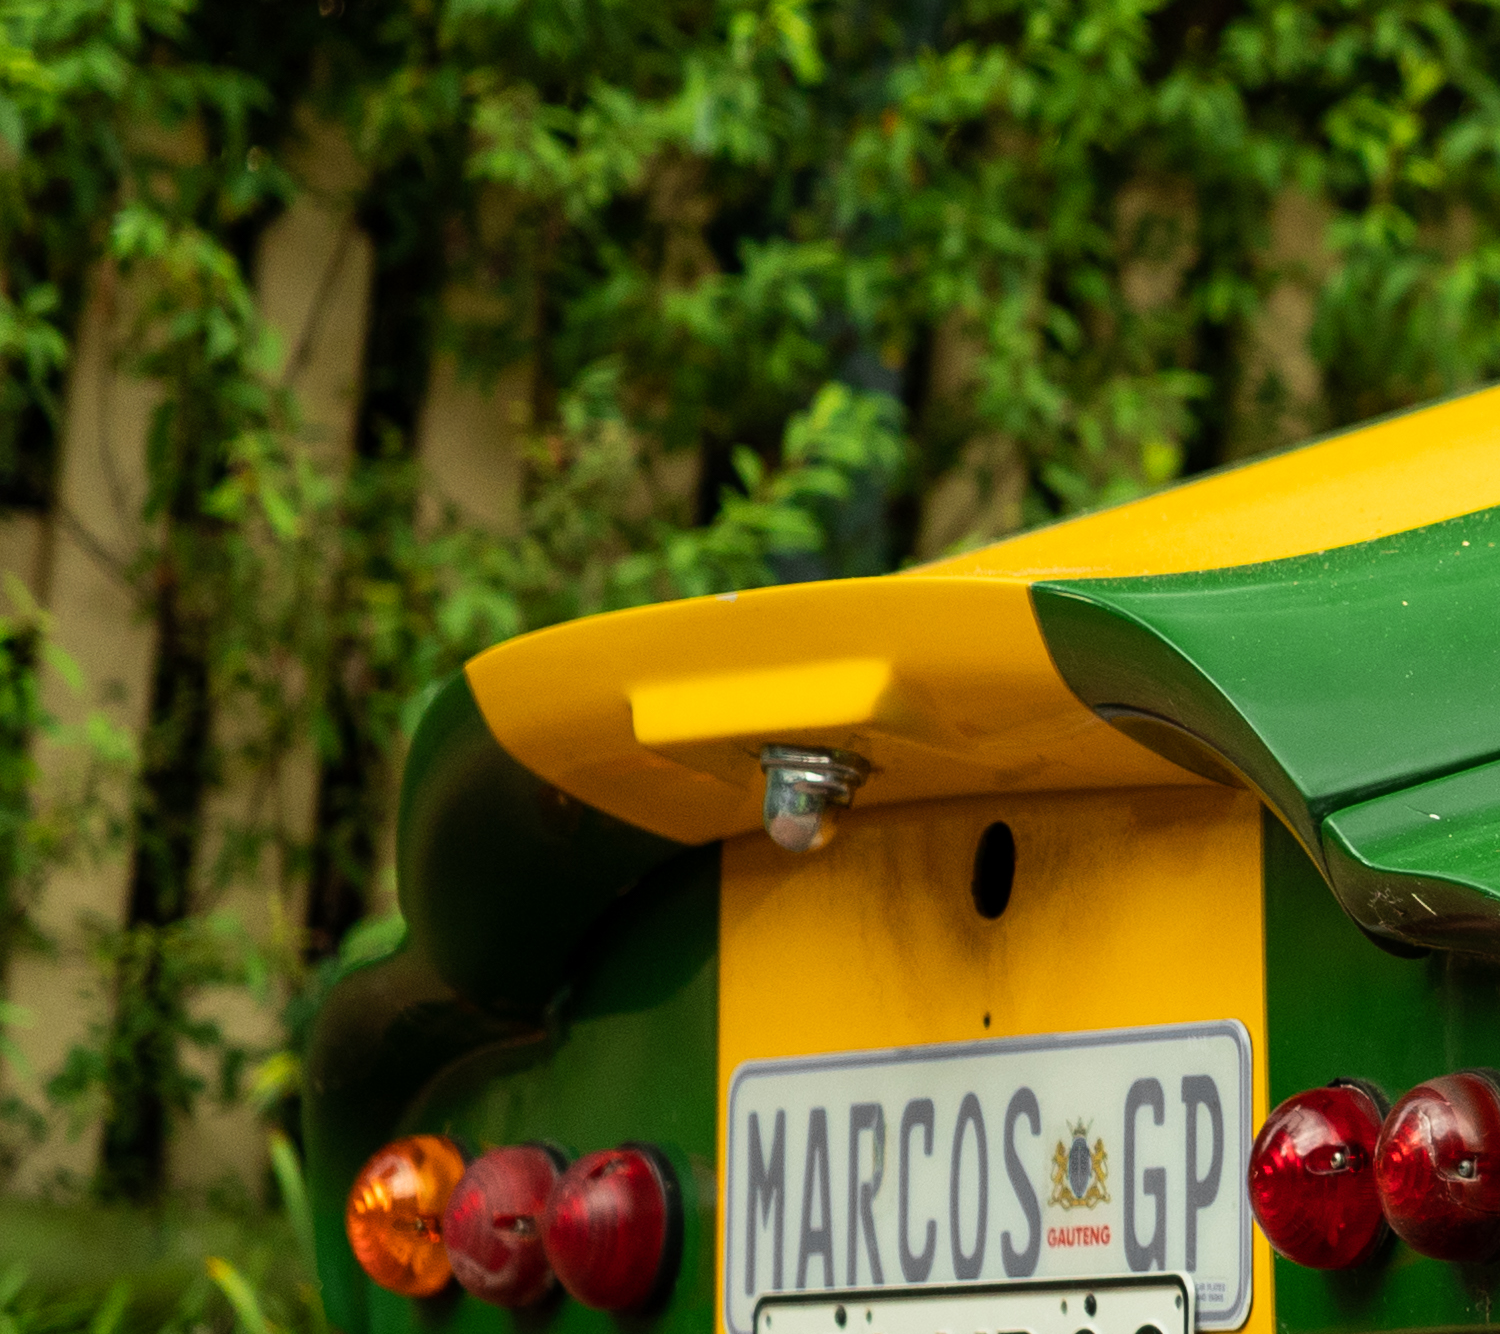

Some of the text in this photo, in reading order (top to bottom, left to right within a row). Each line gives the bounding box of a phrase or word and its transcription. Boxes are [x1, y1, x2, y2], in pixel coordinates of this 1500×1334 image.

[744, 1073, 1225, 1299] MARCOS GP
[1046, 1224, 1111, 1249] GAUTENG
